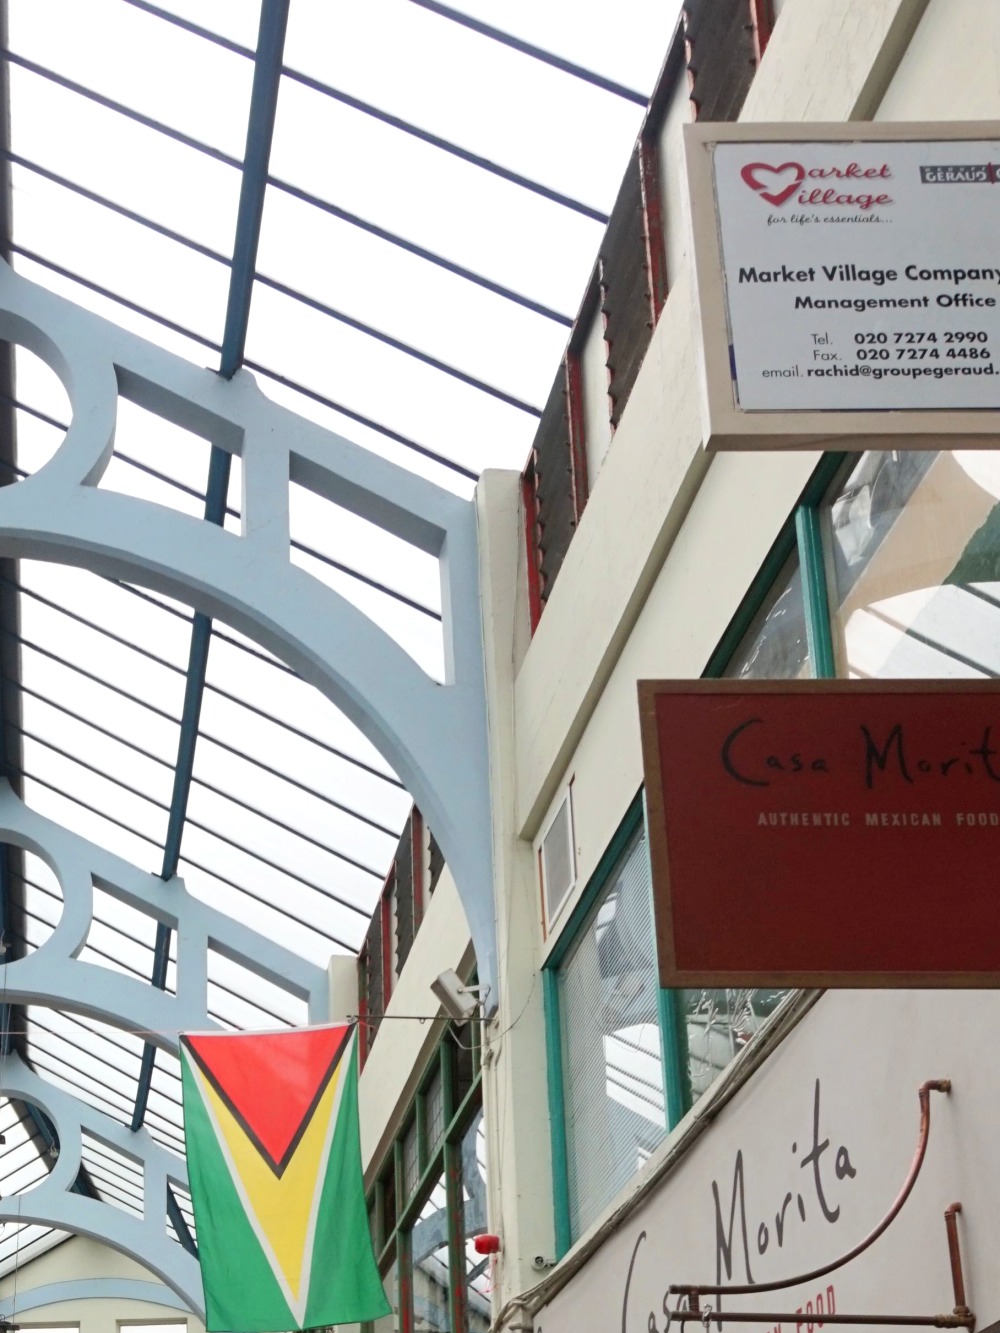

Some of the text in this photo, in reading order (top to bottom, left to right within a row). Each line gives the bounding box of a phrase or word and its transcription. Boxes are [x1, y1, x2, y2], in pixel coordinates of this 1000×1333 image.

[925, 170, 987, 182] GERAUD
[767, 214, 787, 226] for
[790, 213, 821, 226] life's
[738, 265, 816, 284] Market
[821, 264, 898, 287] Village
[794, 293, 996, 313] Management Office
[811, 330, 988, 345] Tel. 020 7274 2990
[813, 347, 991, 361] Fax. 020 7274 4486
[761, 365, 804, 378] email.
[720, 717, 830, 787] Casa
[757, 811, 1000, 827] AUTHENTIC MEXICAN FOOD
[711, 1077, 858, 1333] Morita
